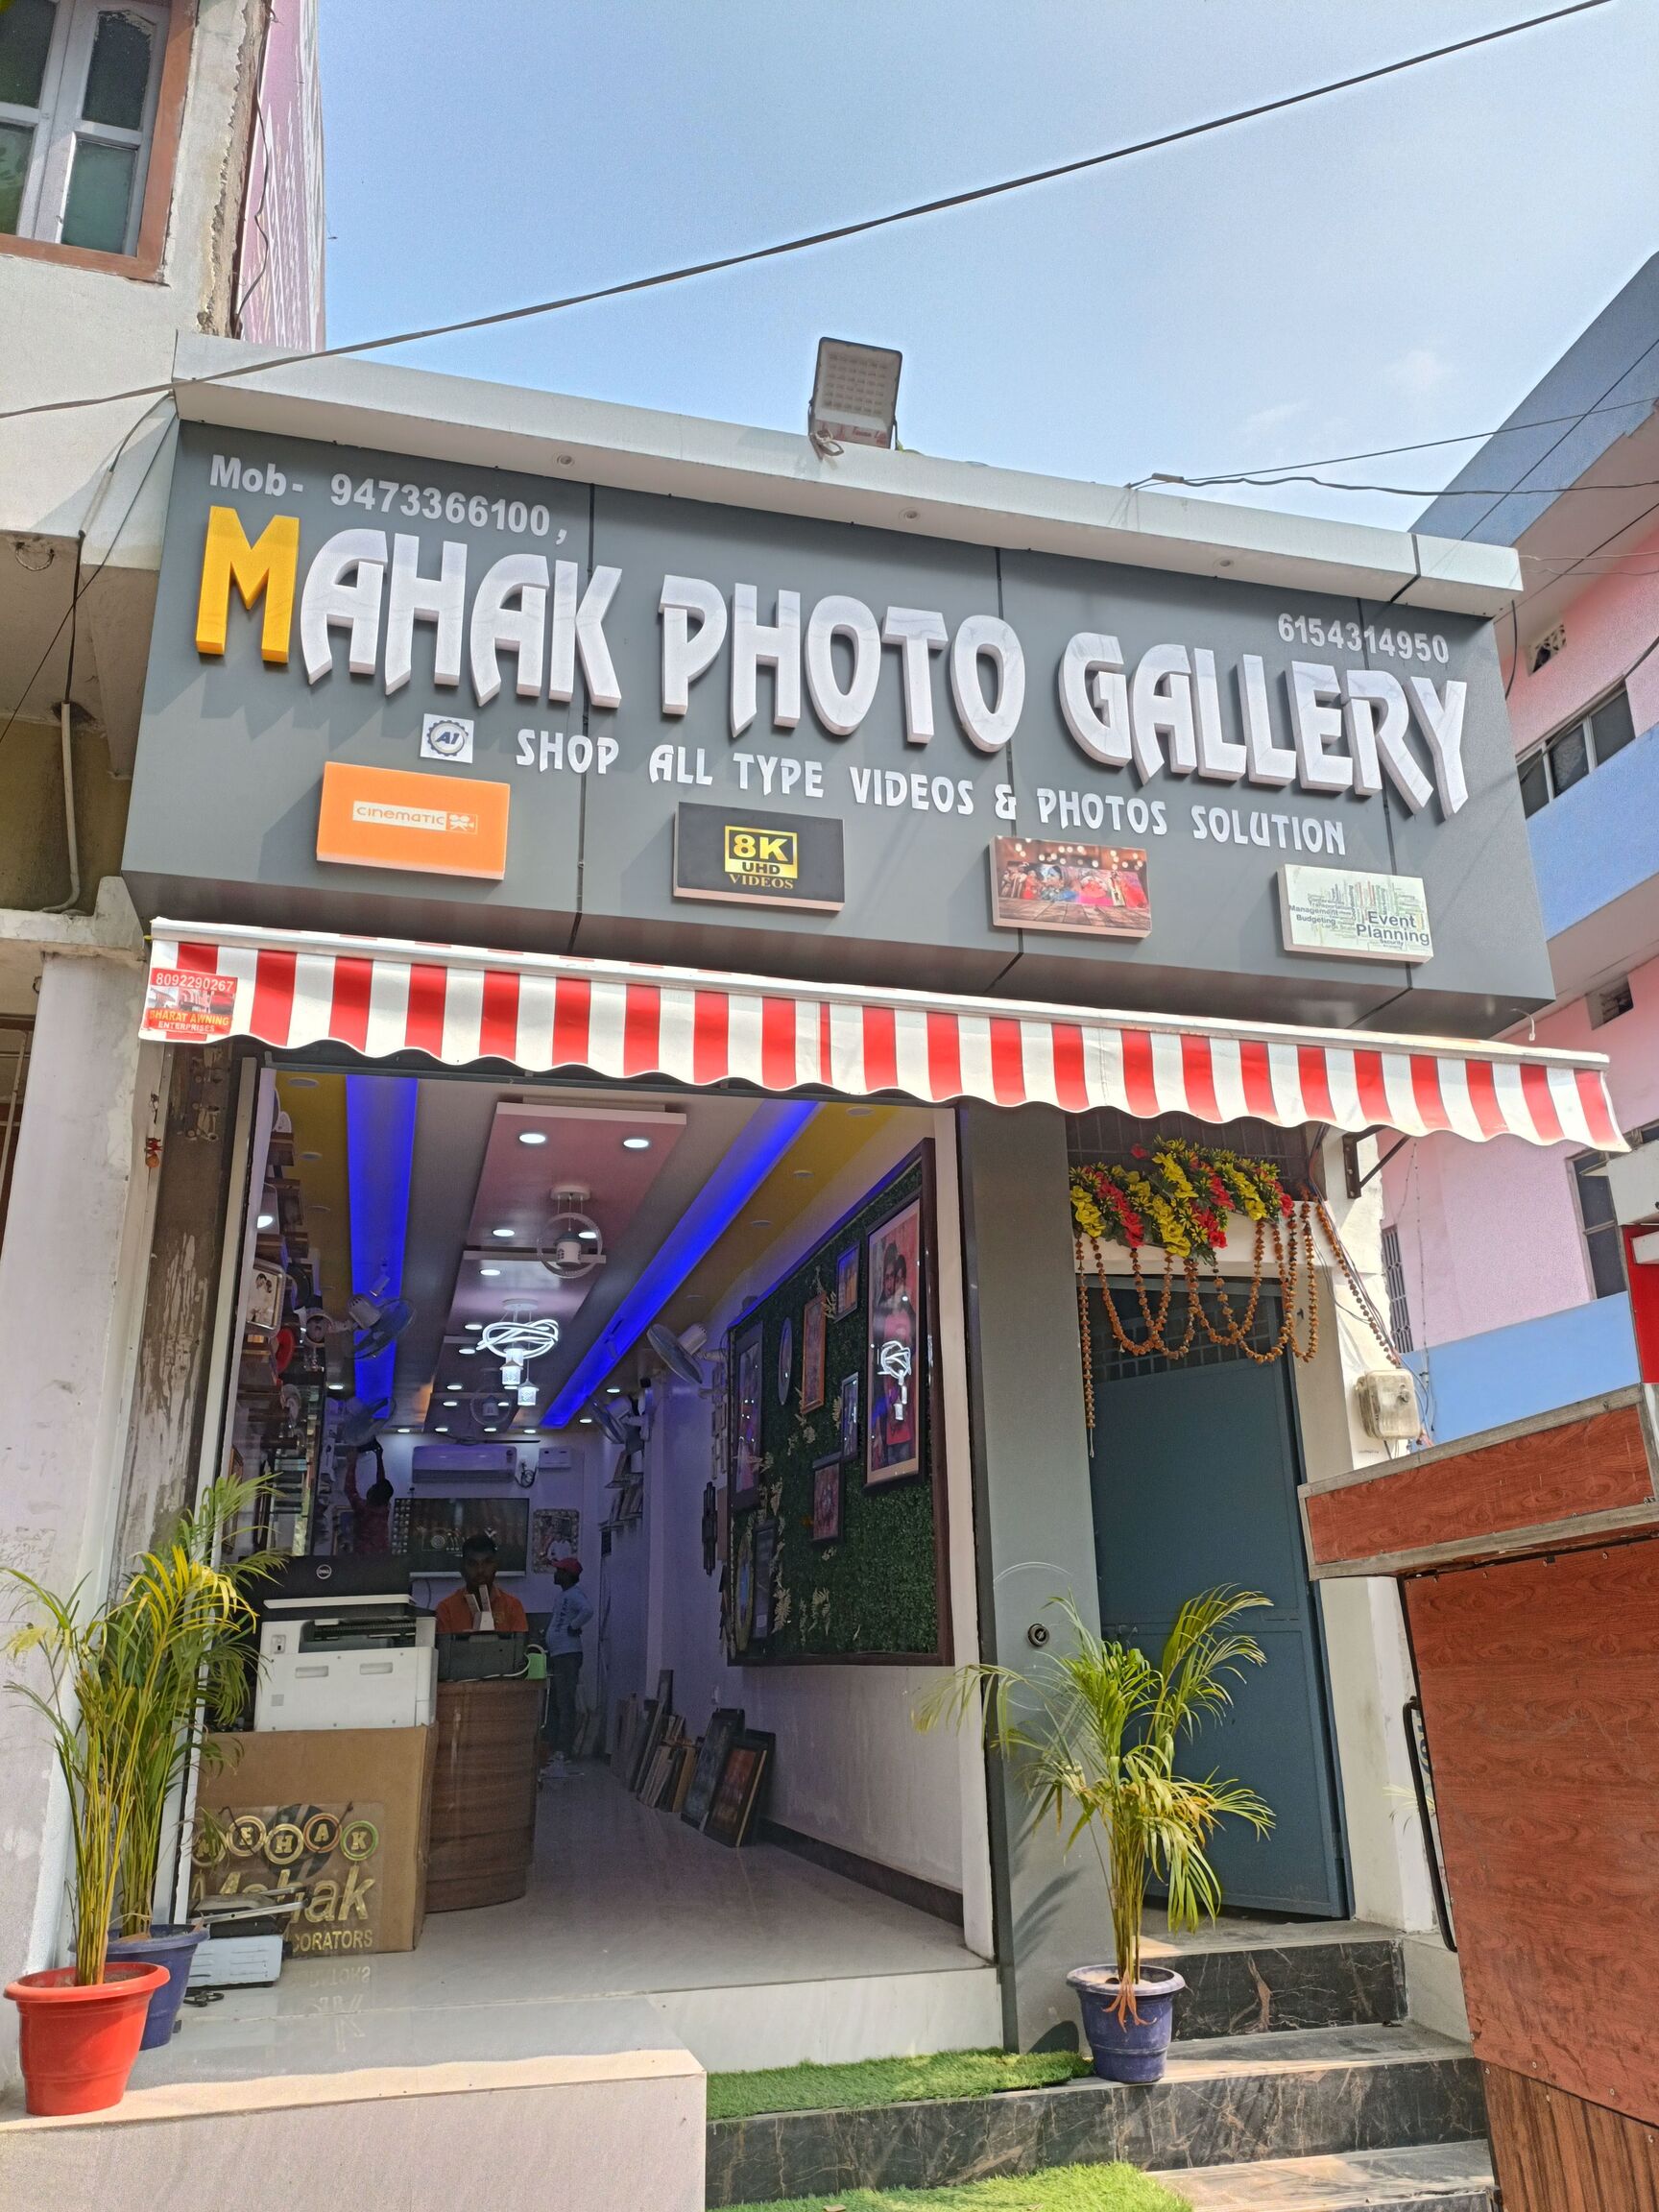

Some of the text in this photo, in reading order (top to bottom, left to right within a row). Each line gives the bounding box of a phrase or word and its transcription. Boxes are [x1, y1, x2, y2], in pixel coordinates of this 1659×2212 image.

[209, 454, 303, 497] Mob-
[1277, 613, 1449, 663] 6154314950
[196, 506, 1468, 819] MAHAK PHOTO GALLERY
[435, 732, 460, 744] AI
[516, 729, 1346, 854] SHOP ALL TYPE VIDEOS & PHOTOS SOLUTION
[356, 805, 445, 826] cinematic
[733, 833, 789, 861] 8K
[742, 861, 781, 875] UHD
[730, 874, 794, 889] VIDEOS
[1296, 914, 1336, 926] Budgeting
[1368, 910, 1416, 927] Event
[1356, 924, 1430, 946] Planning
[156, 973, 234, 992] 8092290267
[157, 1021, 215, 1032] ENTERPRISES
[190, 1014, 229, 1025] AWNING
